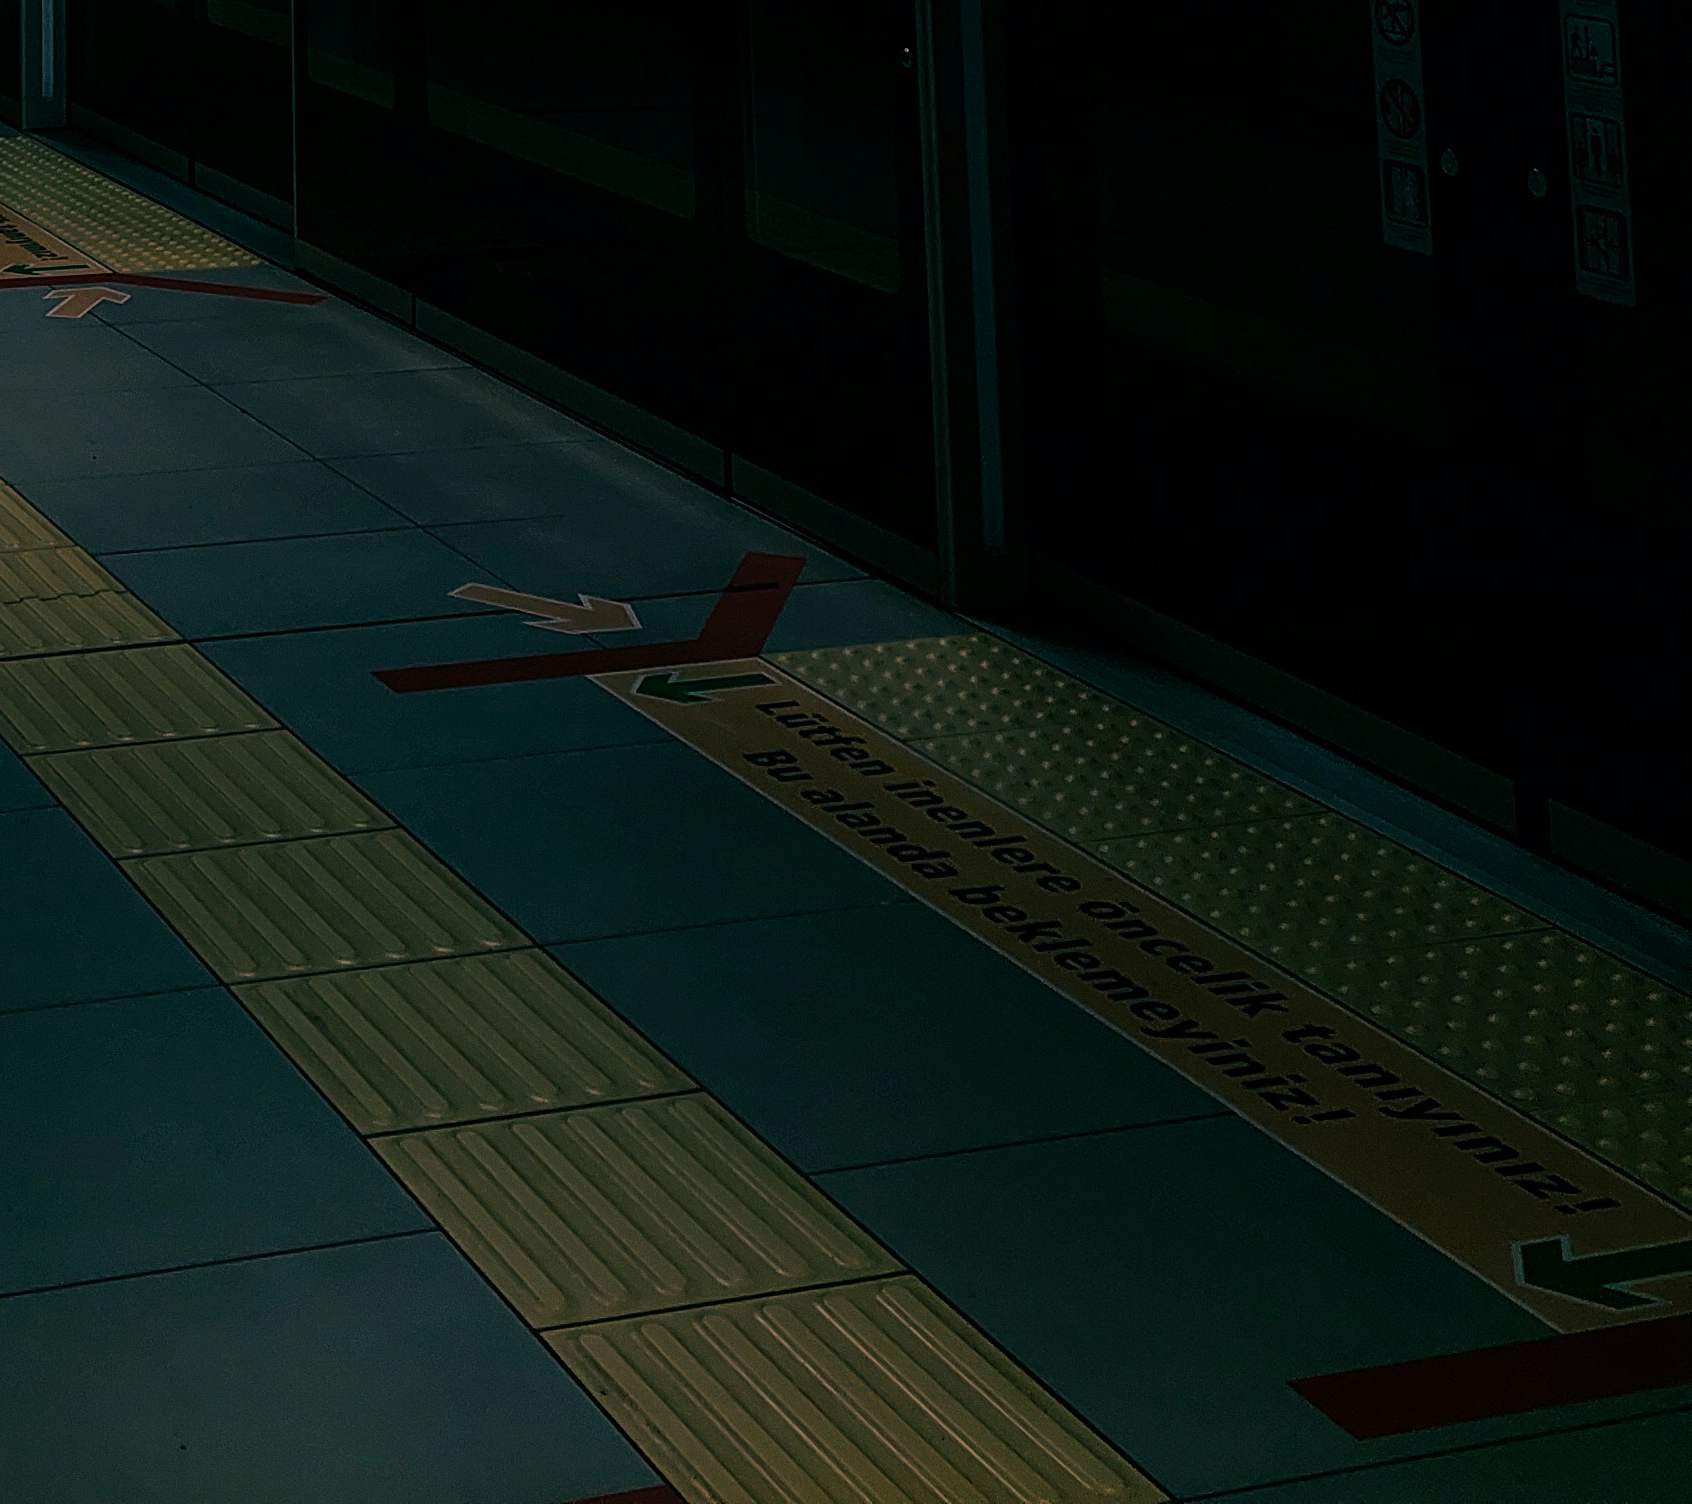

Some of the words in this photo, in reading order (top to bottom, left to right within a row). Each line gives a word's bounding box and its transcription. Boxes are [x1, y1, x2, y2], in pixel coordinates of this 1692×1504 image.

[741, 748, 815, 783] Bu
[800, 788, 960, 879] alanda
[949, 885, 1357, 1125] beklemeyiniz!
[754, 700, 896, 776] Lütfen
[883, 779, 1082, 893] inenlere
[1078, 900, 1289, 1017] öncelik
[1281, 1023, 1622, 1215] tanıyınız!
